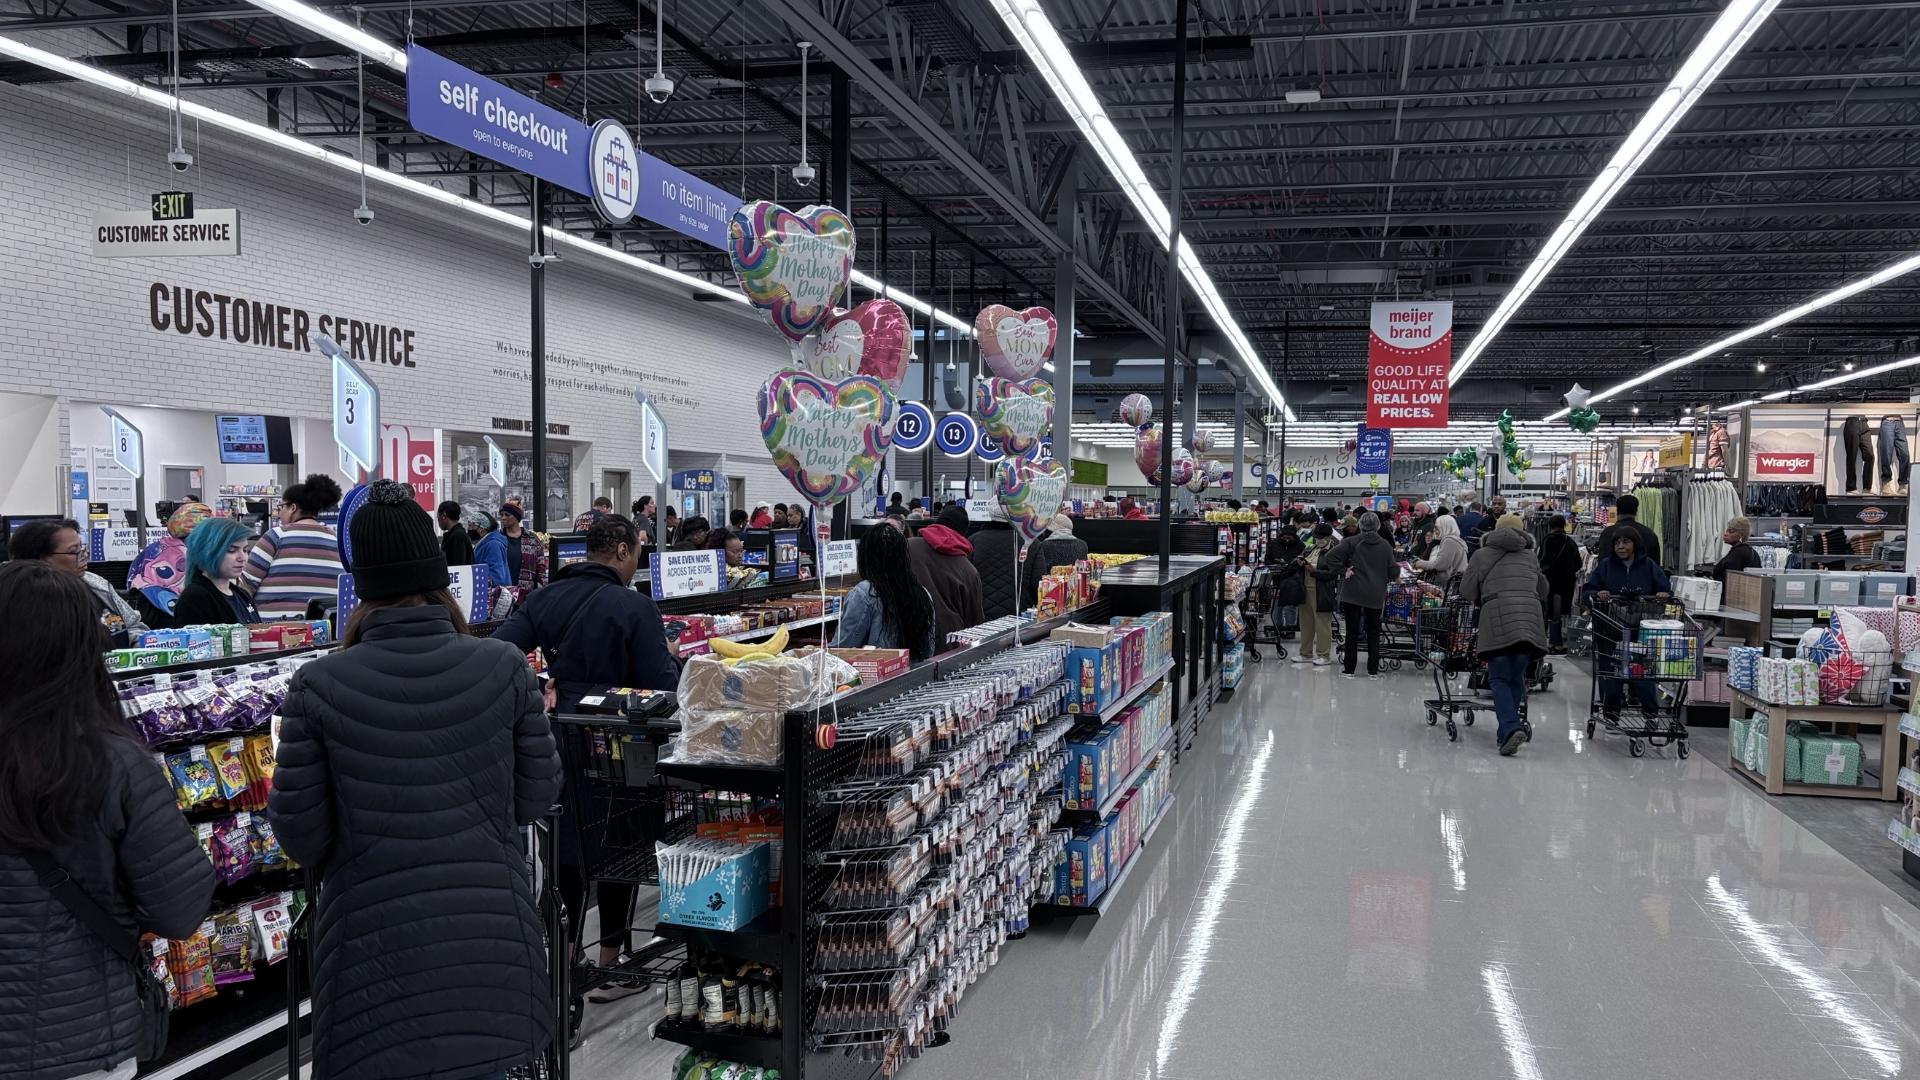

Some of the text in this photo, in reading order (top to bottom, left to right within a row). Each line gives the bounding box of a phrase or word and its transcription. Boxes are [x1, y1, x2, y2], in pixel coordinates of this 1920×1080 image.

[439, 79, 568, 155] self checkout
[473, 128, 534, 160] open to everyone
[160, 194, 185, 219] EXIT
[662, 179, 727, 224] no item limit
[679, 213, 688, 224] any
[98, 222, 230, 243] CUSTOMER SERVICE
[789, 234, 835, 259] Happy
[797, 280, 831, 301] Day!
[1389, 308, 1433, 325] meijer
[150, 282, 416, 368] CUSTOMER SERVICE
[1390, 326, 1432, 338] brand
[814, 332, 839, 357] Best
[1005, 338, 1044, 355] MOM
[496, 341, 508, 353] We
[526, 349, 561, 363] seded
[571, 356, 594, 373] pulling
[1014, 354, 1035, 367] Ever
[1375, 365, 1444, 376] GOOD LIFE
[547, 375, 572, 390] respect
[1372, 379, 1446, 392] QUALITY AT
[1374, 393, 1443, 404] REAL LOW
[346, 398, 354, 424] 3
[1380, 408, 1434, 418] PRICES.
[903, 420, 915, 433] 12
[650, 431, 656, 450] 2
[787, 425, 860, 452] Mother's
[949, 428, 960, 441] 13
[121, 437, 127, 452] 8
[493, 458, 498, 469] 6
[806, 449, 846, 471] Day!
[1761, 457, 1810, 471] Wrangler
[684, 474, 696, 489] ice
[114, 530, 131, 538] SAVE
[132, 530, 150, 538] EN
[112, 538, 138, 546] ACROSS
[668, 554, 710, 566] SAVE EVEN MORE
[449, 571, 460, 583] RE
[667, 564, 712, 577] ACROSS THE STORE
[146, 639, 180, 649] mentos
[105, 656, 119, 664] xtra
[137, 654, 158, 666] Extra
